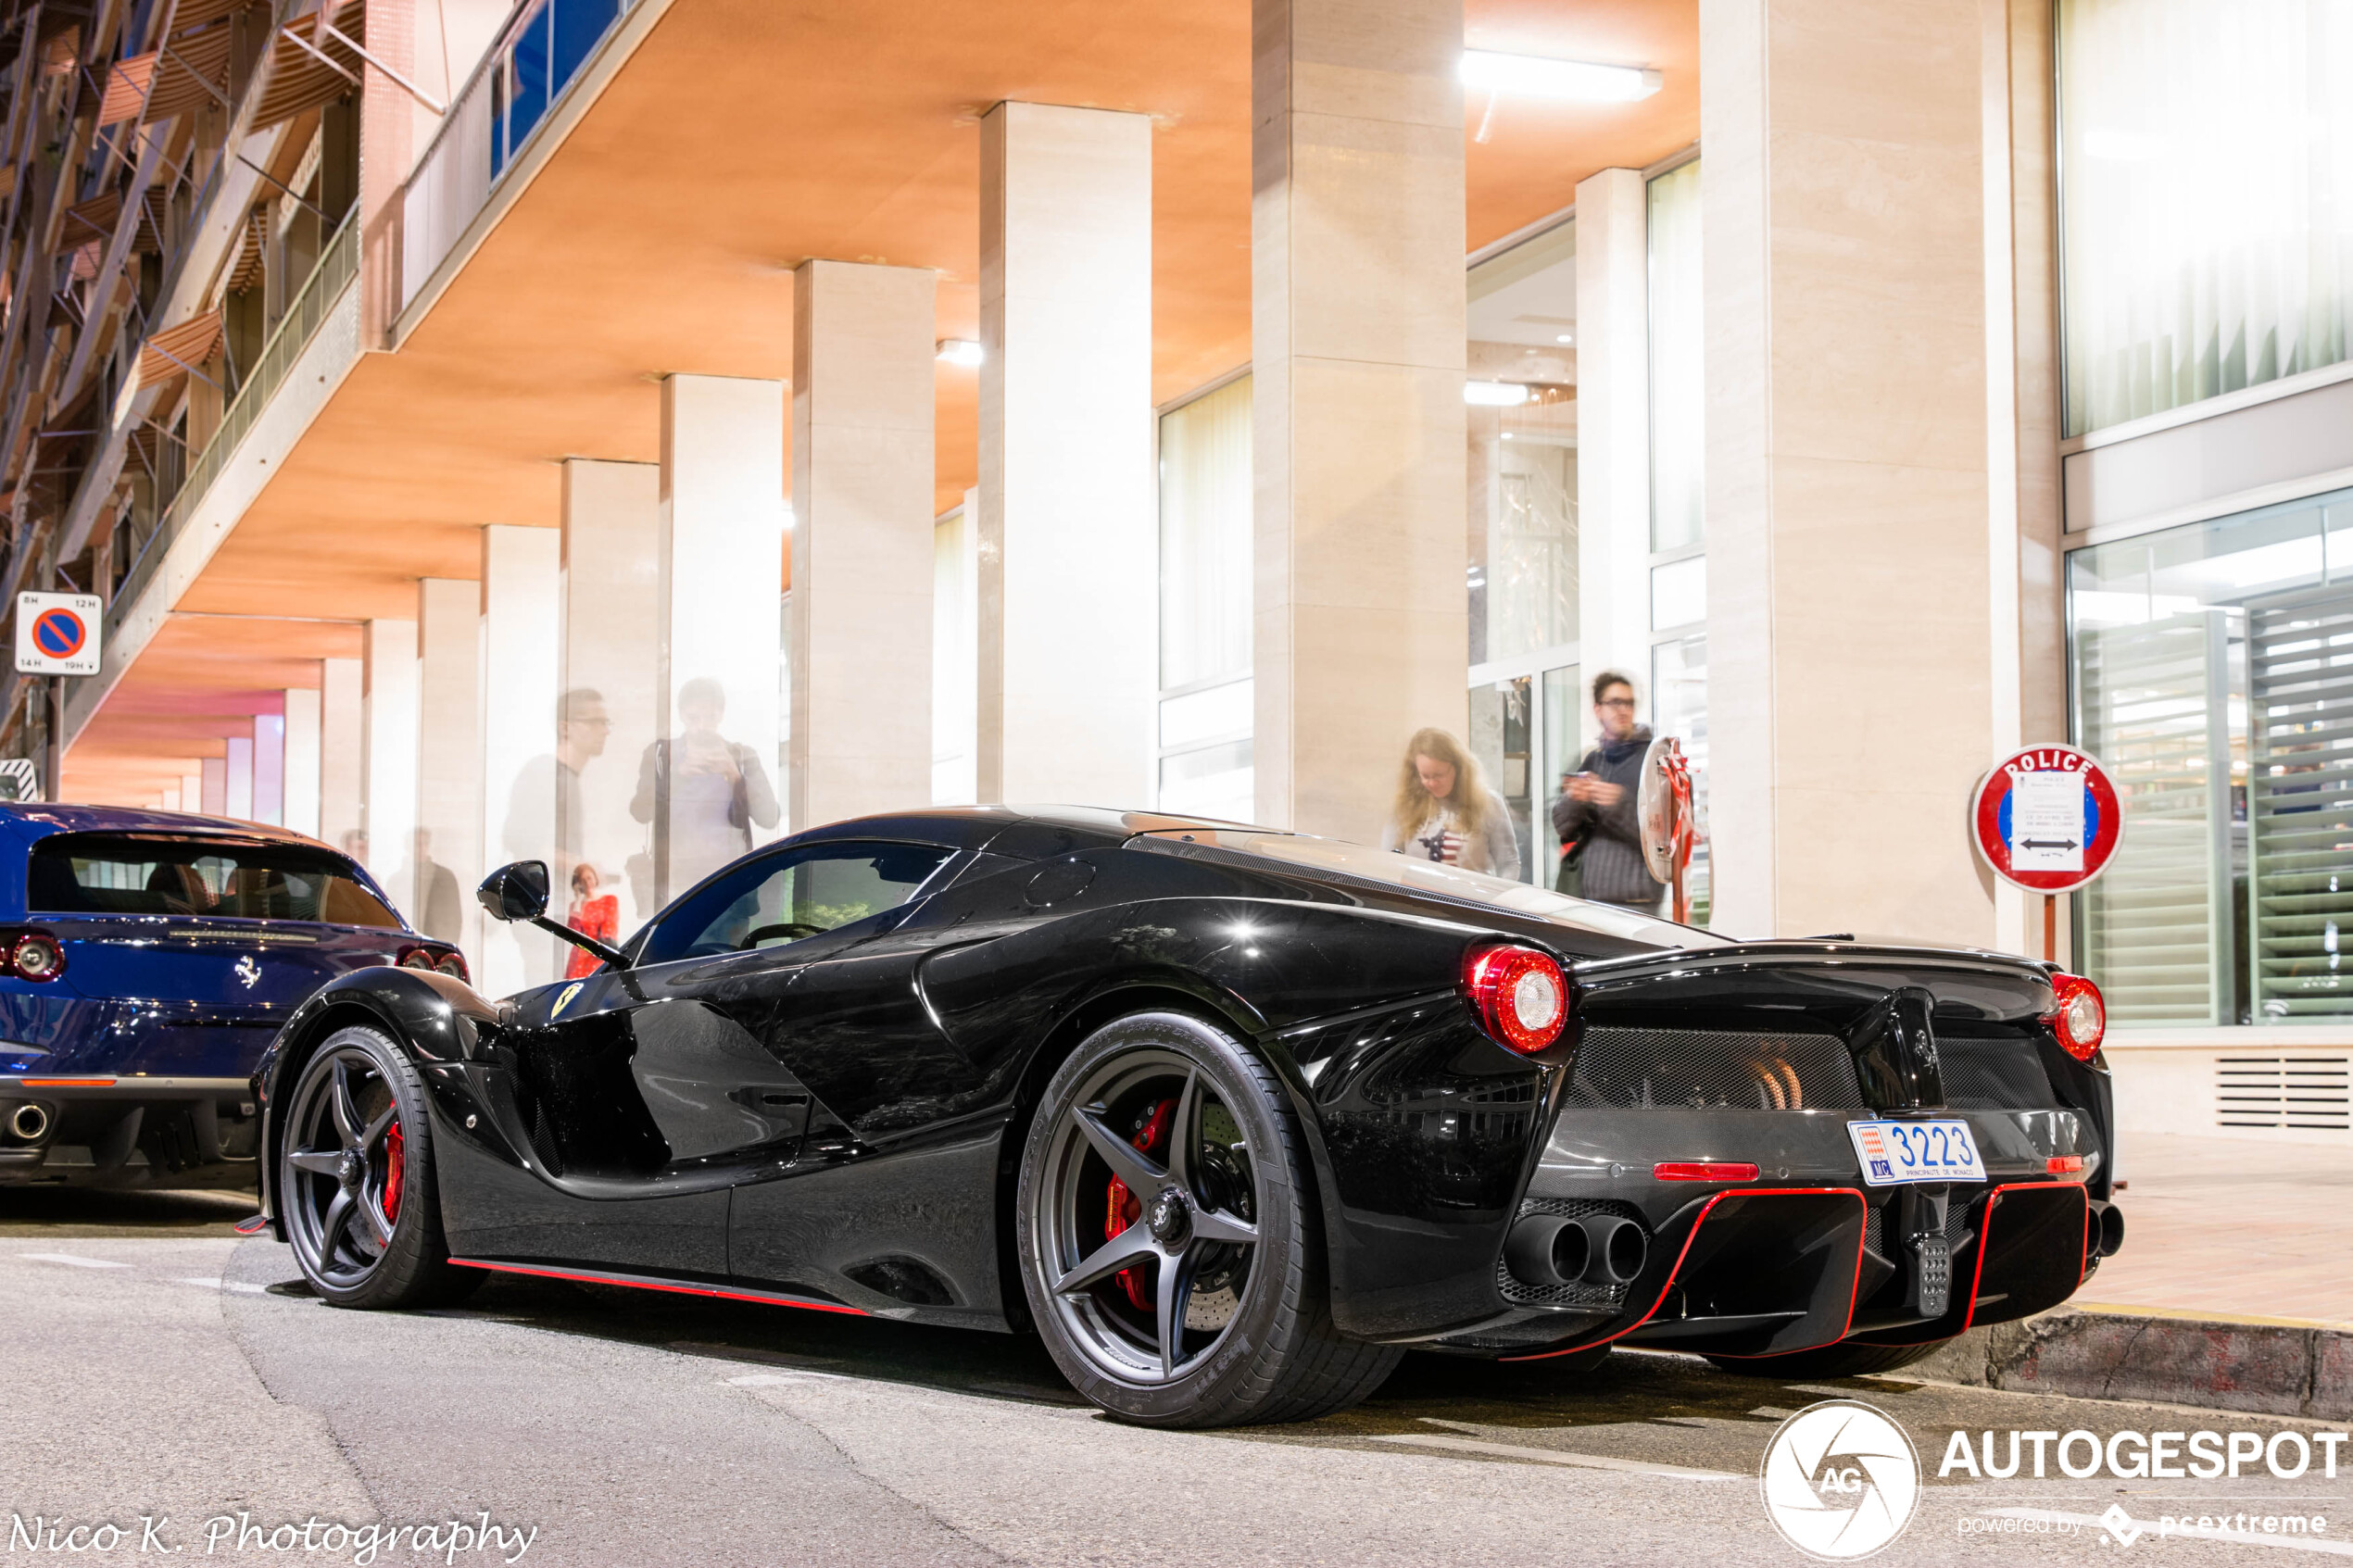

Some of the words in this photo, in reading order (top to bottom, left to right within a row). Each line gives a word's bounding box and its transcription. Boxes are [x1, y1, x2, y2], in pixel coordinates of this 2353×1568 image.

[2004, 750, 2094, 779] POLICE
[1892, 1126, 1973, 1166] 3223
[1873, 1161, 1889, 1175] MC
